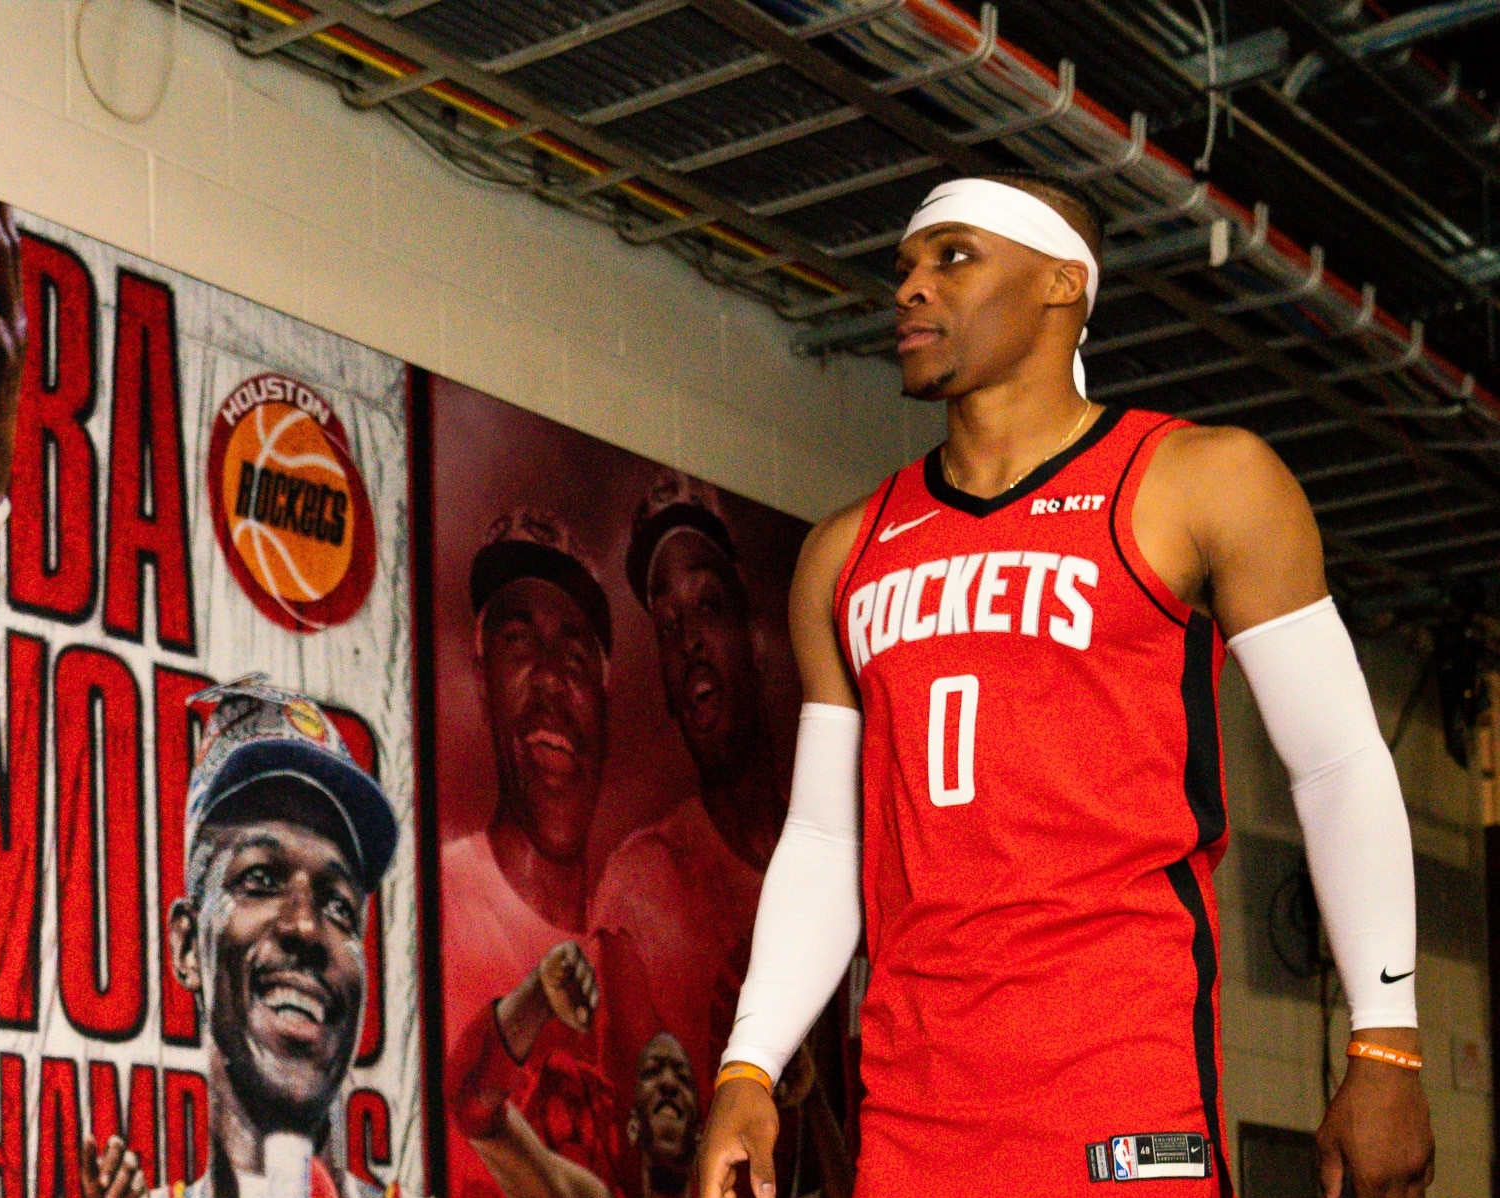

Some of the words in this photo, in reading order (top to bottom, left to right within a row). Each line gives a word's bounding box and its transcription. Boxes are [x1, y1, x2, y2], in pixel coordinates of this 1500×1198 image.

[221, 376, 330, 427] HOUSTON
[847, 550, 1100, 678] ROCKETS
[927, 673, 980, 808] 0
